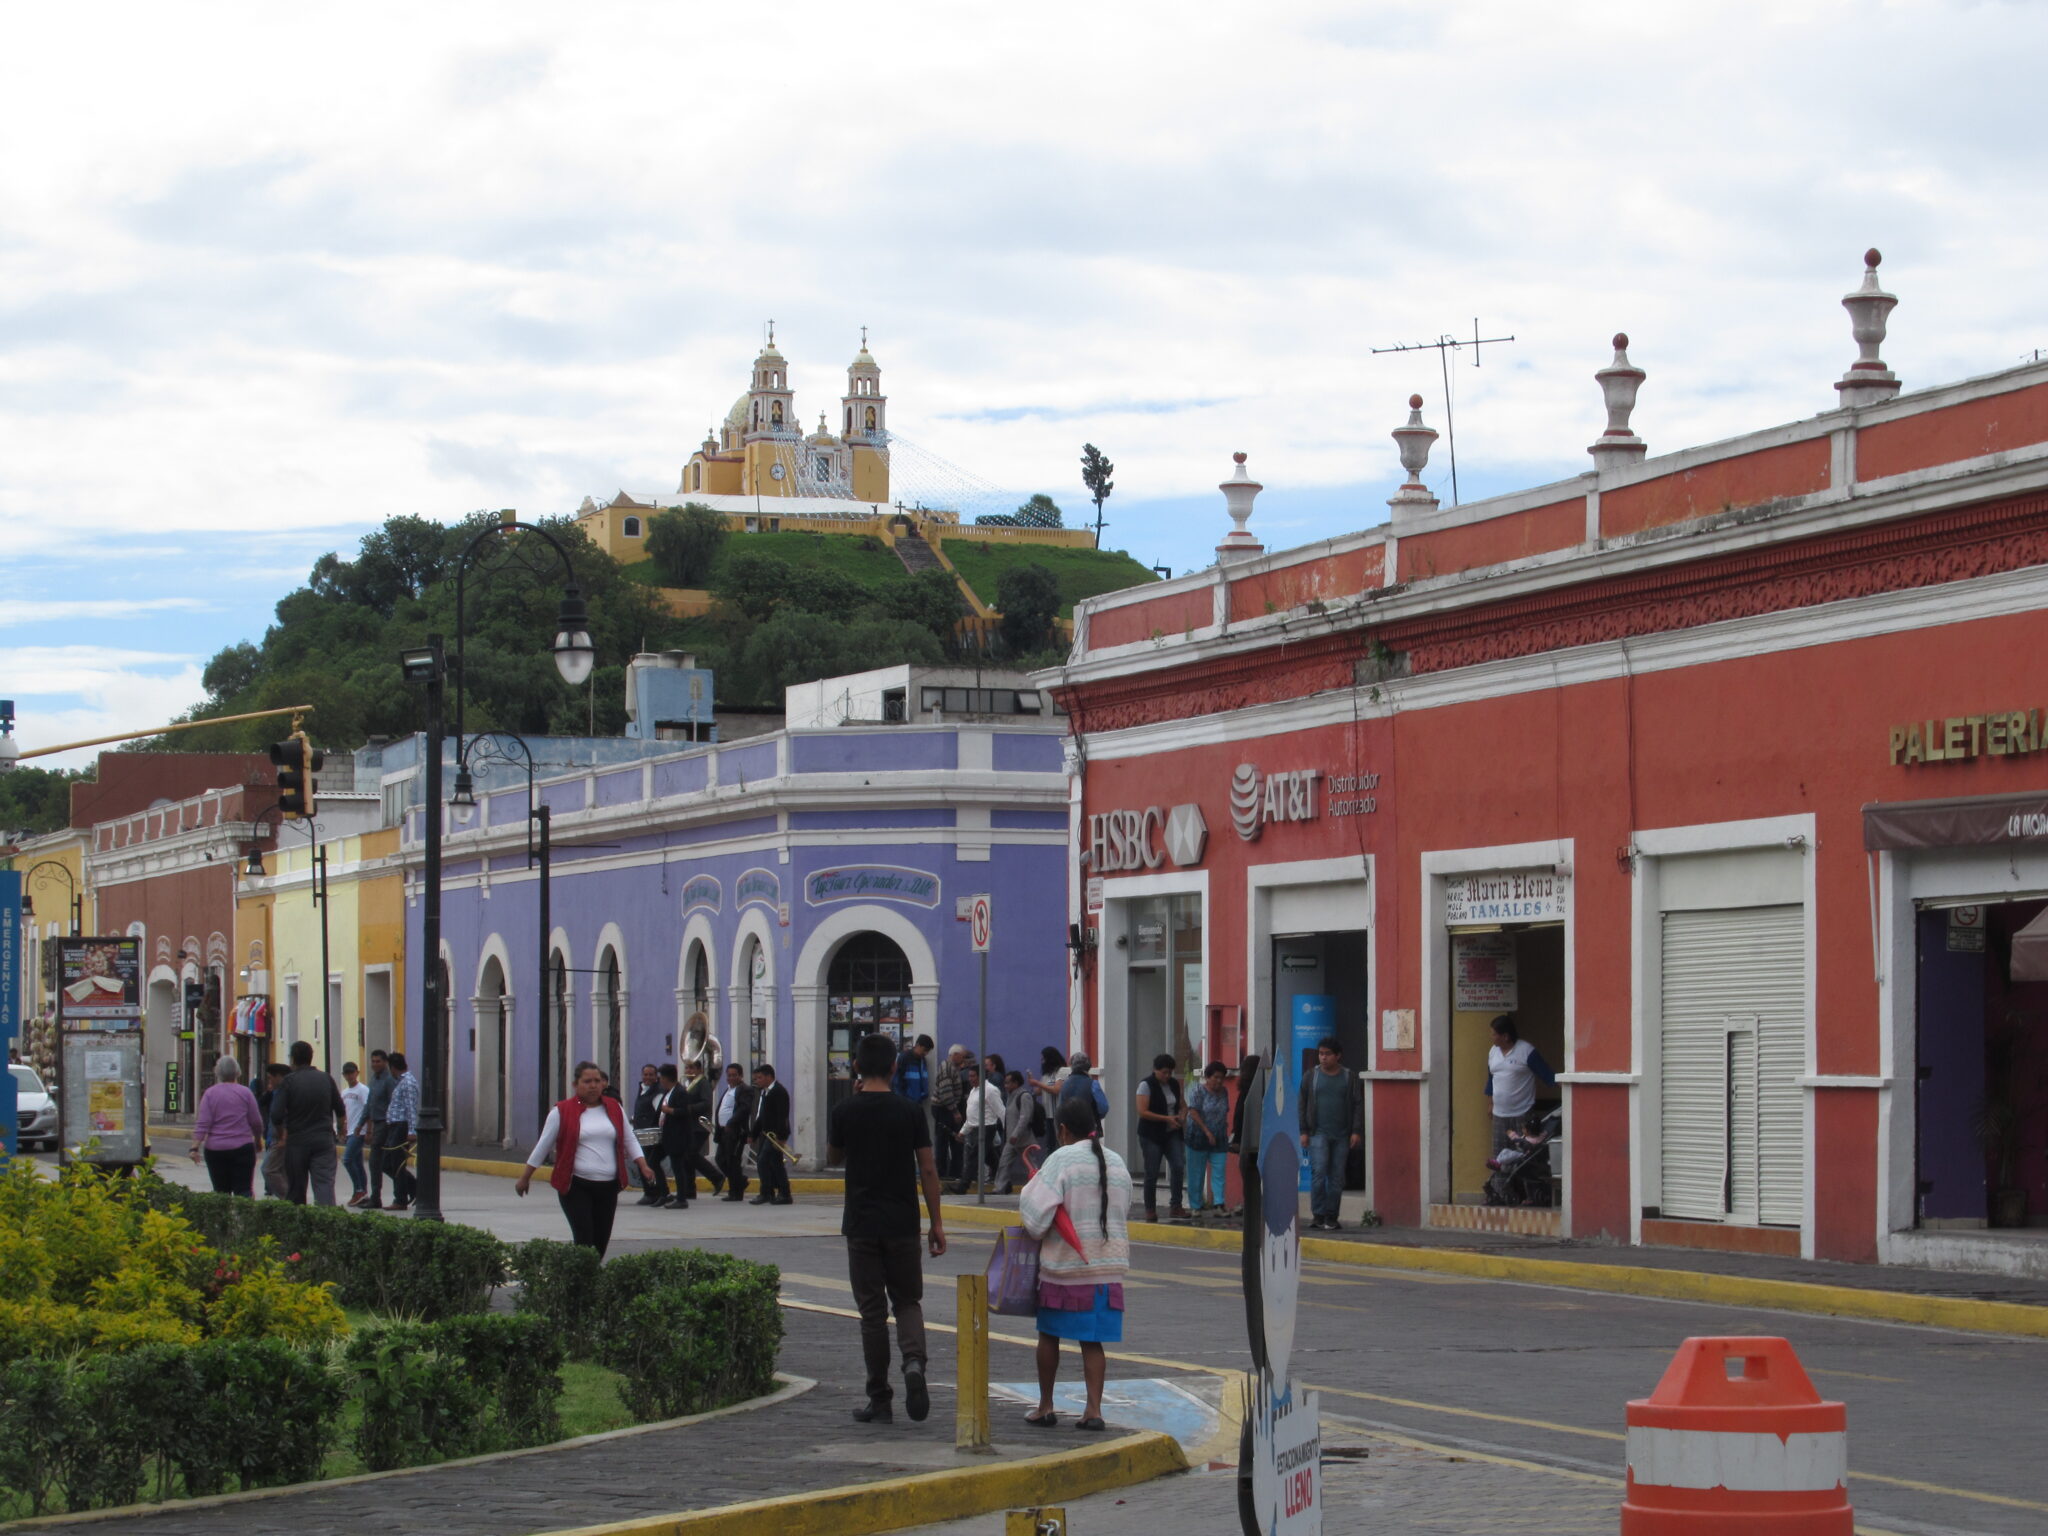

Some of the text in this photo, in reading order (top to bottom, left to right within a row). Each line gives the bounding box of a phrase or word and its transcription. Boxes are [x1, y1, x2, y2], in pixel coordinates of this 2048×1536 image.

[1262, 768, 1321, 823] AT&T
[1088, 805, 1165, 872] HSBC
[2008, 813, 2048, 837] LA MOR
[1466, 875, 1510, 903] Maria
[1512, 874, 1553, 900] Elena
[1470, 901, 1542, 919] TAMALES
[1, 907, 12, 1025] EMERGENCIAS
[168, 1071, 177, 1110] FOTO
[1277, 1438, 1318, 1475] ESTACIONAMIENTO
[1285, 1468, 1312, 1518] LLENO
